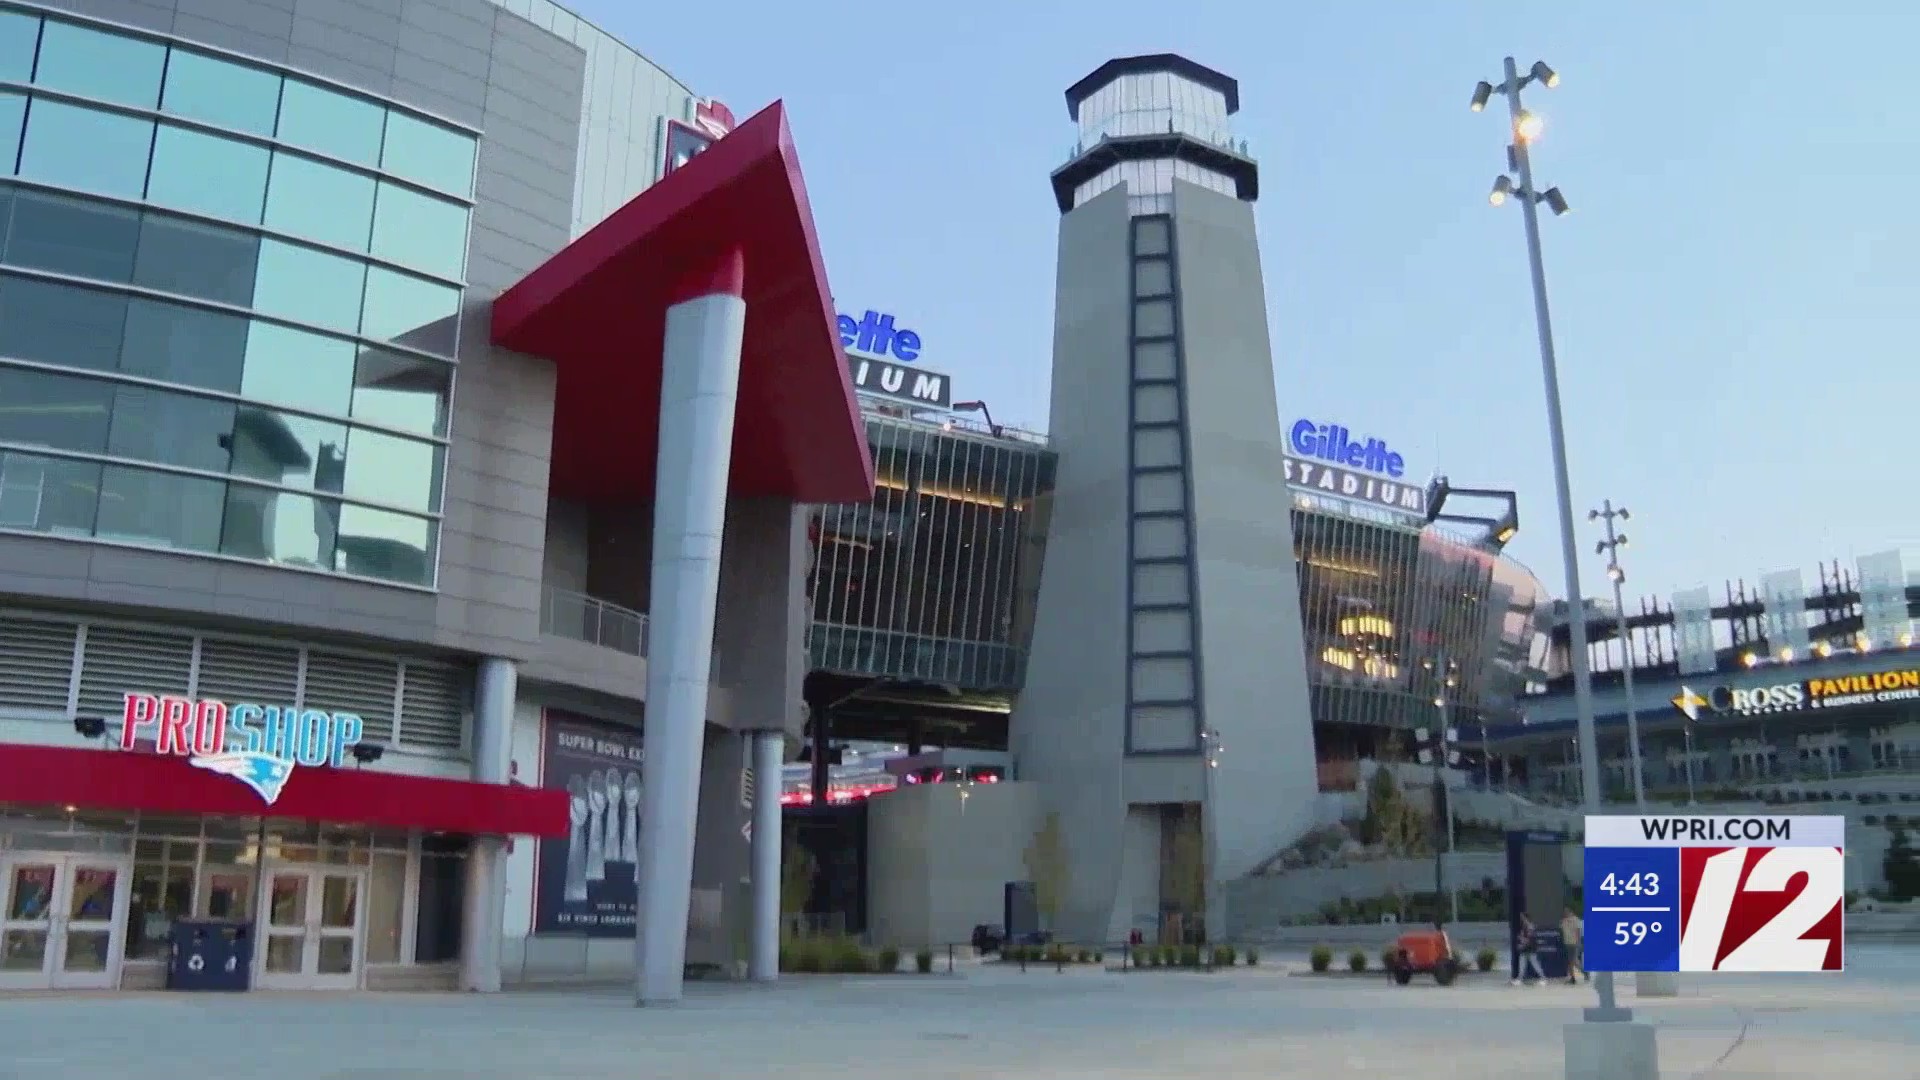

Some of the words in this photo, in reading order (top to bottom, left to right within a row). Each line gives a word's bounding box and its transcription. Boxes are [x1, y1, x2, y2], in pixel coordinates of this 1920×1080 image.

[837, 310, 922, 362] ette
[1291, 418, 1404, 478] Gillette
[1283, 459, 1418, 510] STADIUM
[1808, 670, 1920, 697] PAVILION
[559, 732, 594, 752] SUPER
[597, 740, 625, 758] BOWL
